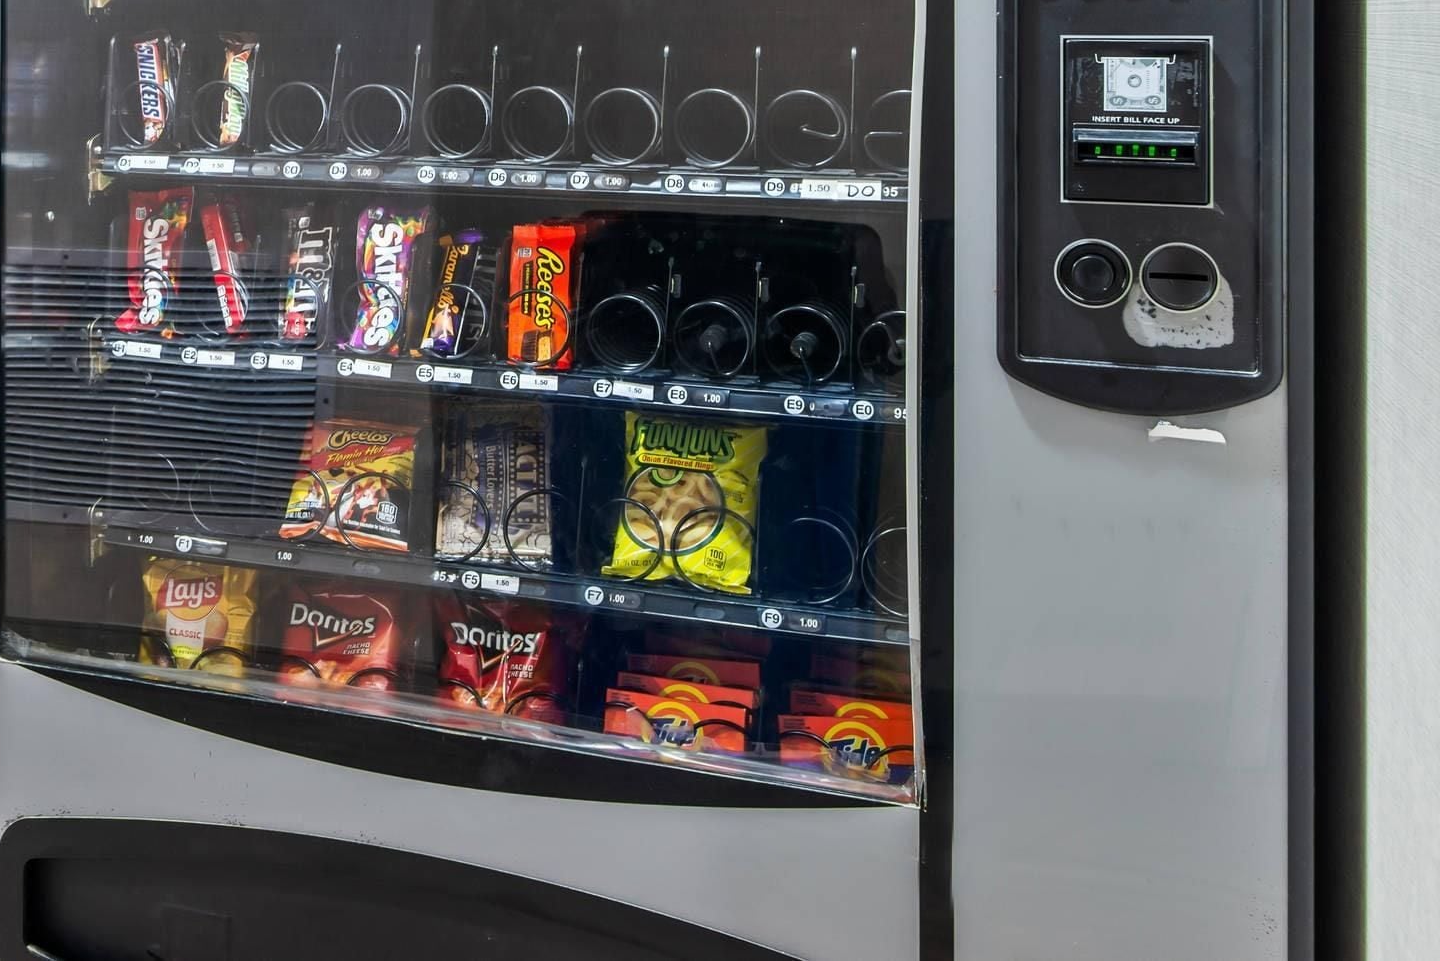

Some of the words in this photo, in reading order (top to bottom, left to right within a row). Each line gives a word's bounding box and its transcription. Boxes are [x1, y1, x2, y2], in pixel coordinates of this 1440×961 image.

[137, 44, 160, 119] SNICKERS
[1123, 116, 1141, 124] BILL
[332, 165, 346, 175] D4
[356, 167, 372, 177] 1.00
[419, 169, 434, 180] D5
[442, 171, 458, 180] 1.00
[490, 172, 505, 182] D6
[520, 173, 537, 183] 1.00
[572, 175, 588, 185] D7
[666, 178, 682, 188] D8
[767, 181, 783, 192] D9
[808, 184, 831, 193] 1.50
[183, 350, 197, 360] E2
[252, 355, 266, 365] E3
[339, 362, 353, 372] E4
[418, 368, 432, 378] E5
[502, 374, 517, 385] E6
[596, 382, 610, 393] E7
[670, 389, 686, 401] E8
[703, 393, 721, 404] 1.00
[787, 398, 803, 411] E9
[328, 429, 392, 449] Cheetos
[485, 445, 497, 477] Butter
[641, 454, 662, 464] Onion
[663, 456, 693, 468] Flavored
[485, 477, 498, 509] Lovers
[139, 534, 153, 544] 1.00
[277, 550, 293, 561] 1.00
[709, 548, 724, 560] 100
[464, 574, 478, 585] F5
[165, 577, 218, 608] Lay's
[587, 590, 602, 602] F7
[290, 603, 376, 635] Doritos
[764, 611, 781, 624] F9
[799, 617, 818, 629] 1.00
[169, 627, 202, 640] CLASSIC
[450, 621, 539, 653] Doritos
[346, 641, 371, 649] NACHO
[342, 647, 370, 656] CHEESE
[510, 663, 533, 672] NACHO
